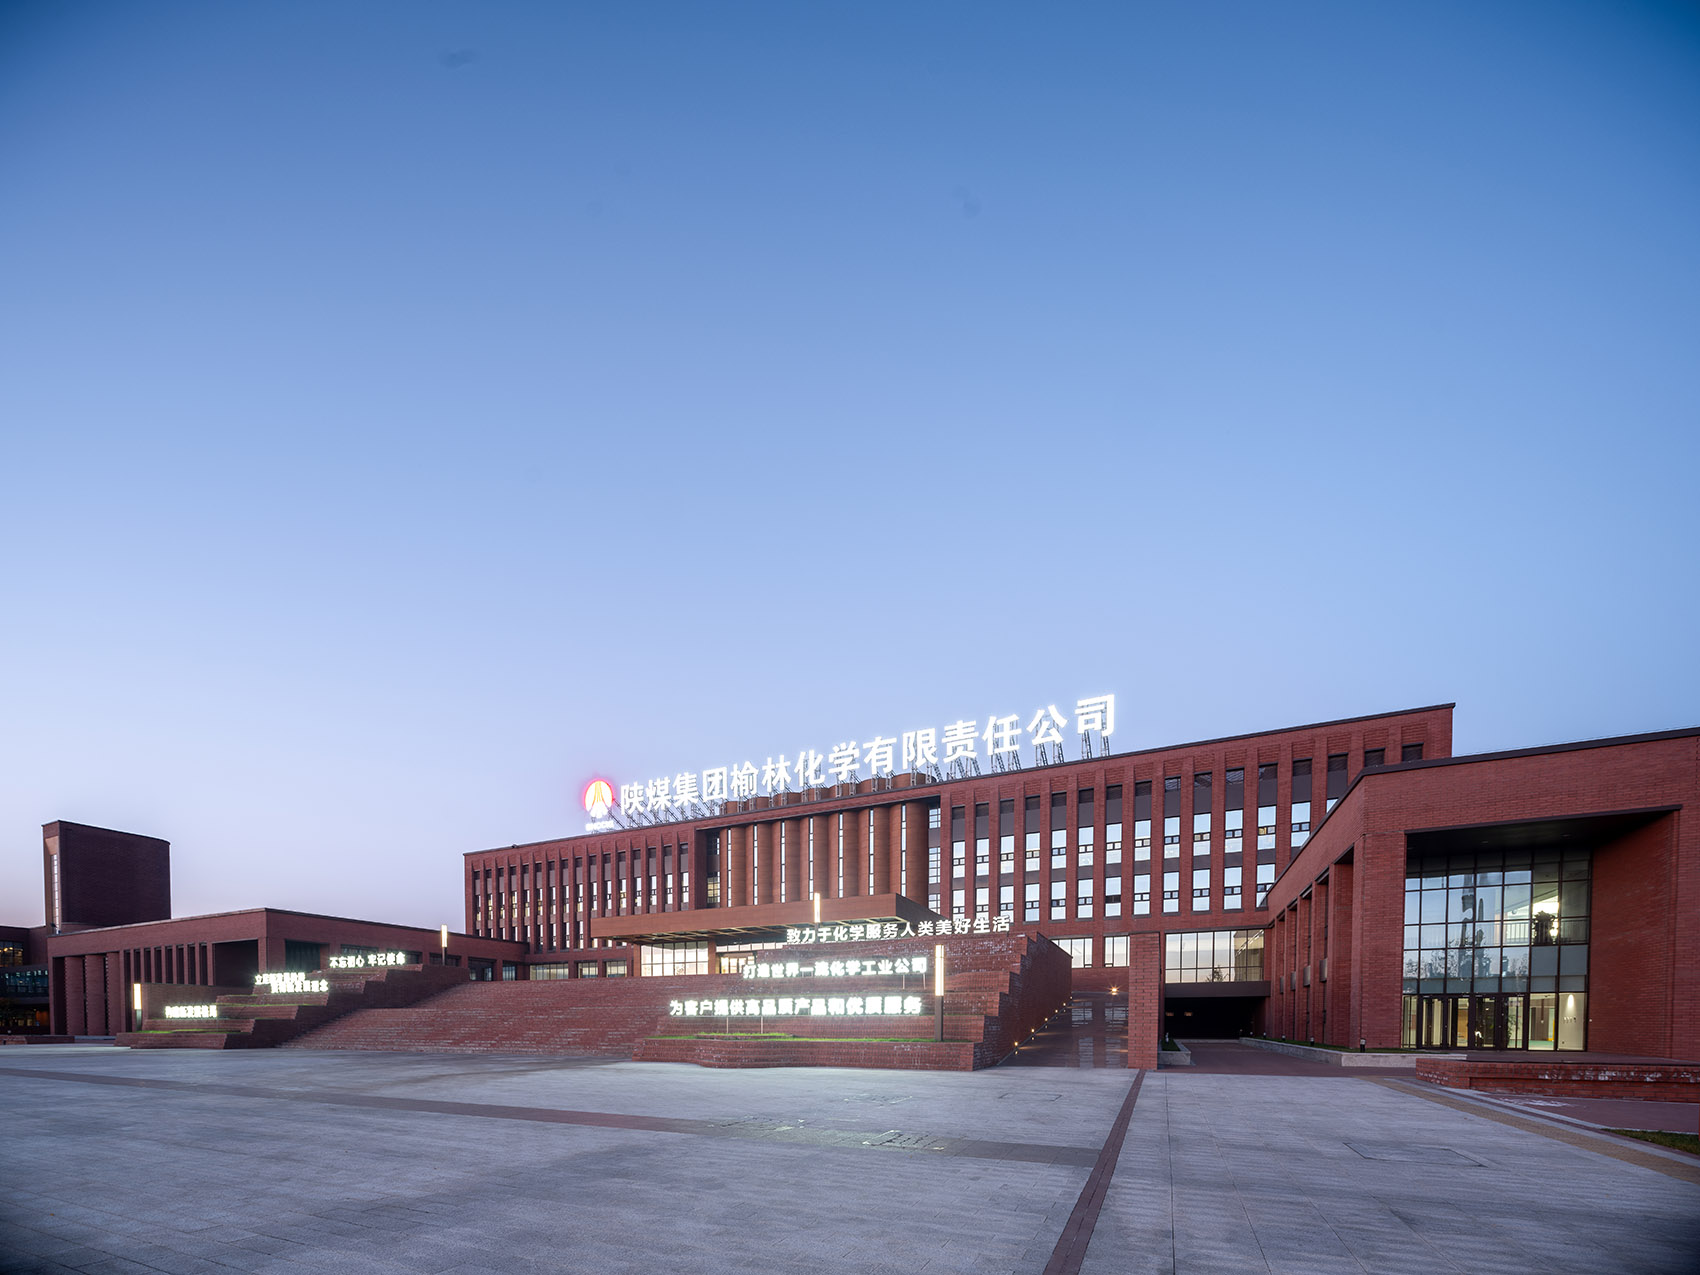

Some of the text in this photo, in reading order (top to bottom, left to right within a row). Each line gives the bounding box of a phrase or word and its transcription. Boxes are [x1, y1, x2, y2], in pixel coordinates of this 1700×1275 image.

[620, 694, 1116, 816] 陕煤集团榆林化学有限责任公司
[786, 915, 1011, 944] 致力于化学服务人类美好生活
